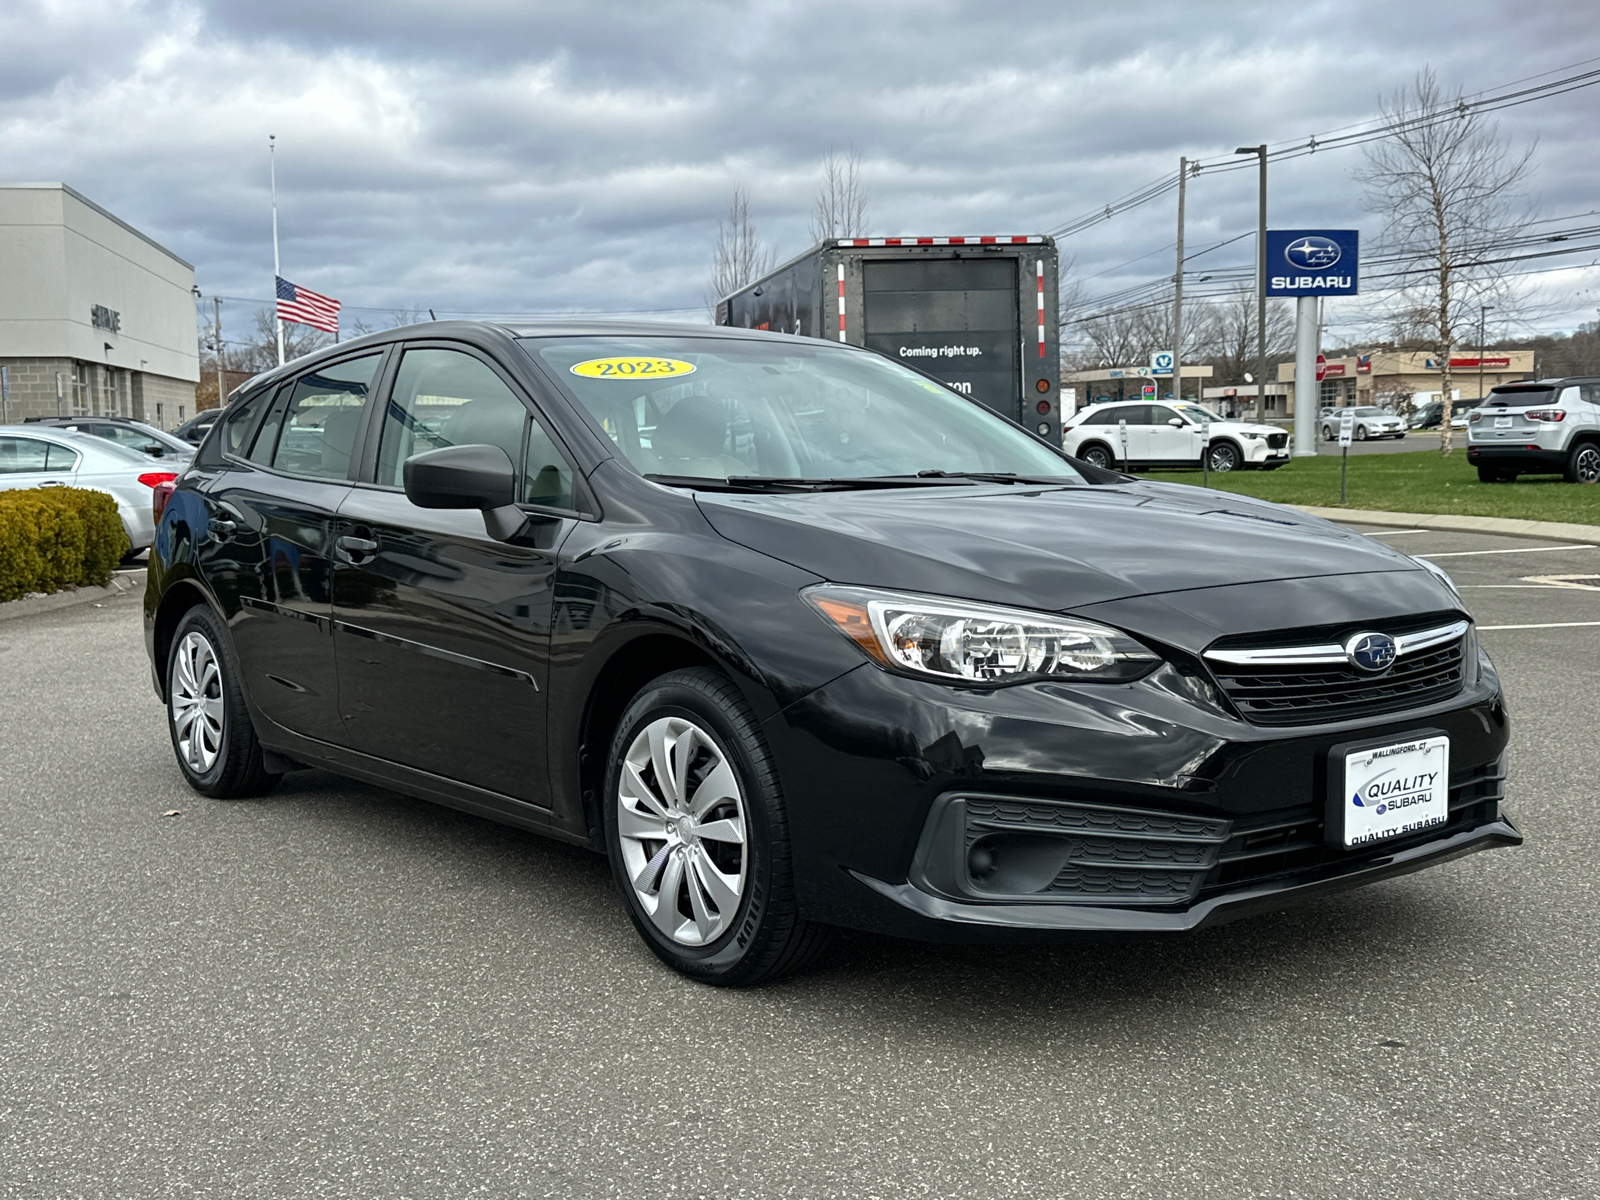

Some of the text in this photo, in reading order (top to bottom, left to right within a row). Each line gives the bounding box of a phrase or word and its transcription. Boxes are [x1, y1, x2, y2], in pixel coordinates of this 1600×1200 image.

[1271, 276, 1351, 289] SUBARU
[899, 345, 982, 358] Coming right up.
[596, 361, 676, 376] 2023
[1418, 742, 1427, 750] CT
[1368, 772, 1438, 798] QUALITY
[1388, 792, 1432, 811] SUBARU
[1351, 815, 1445, 845] QUALITY SUBARU
